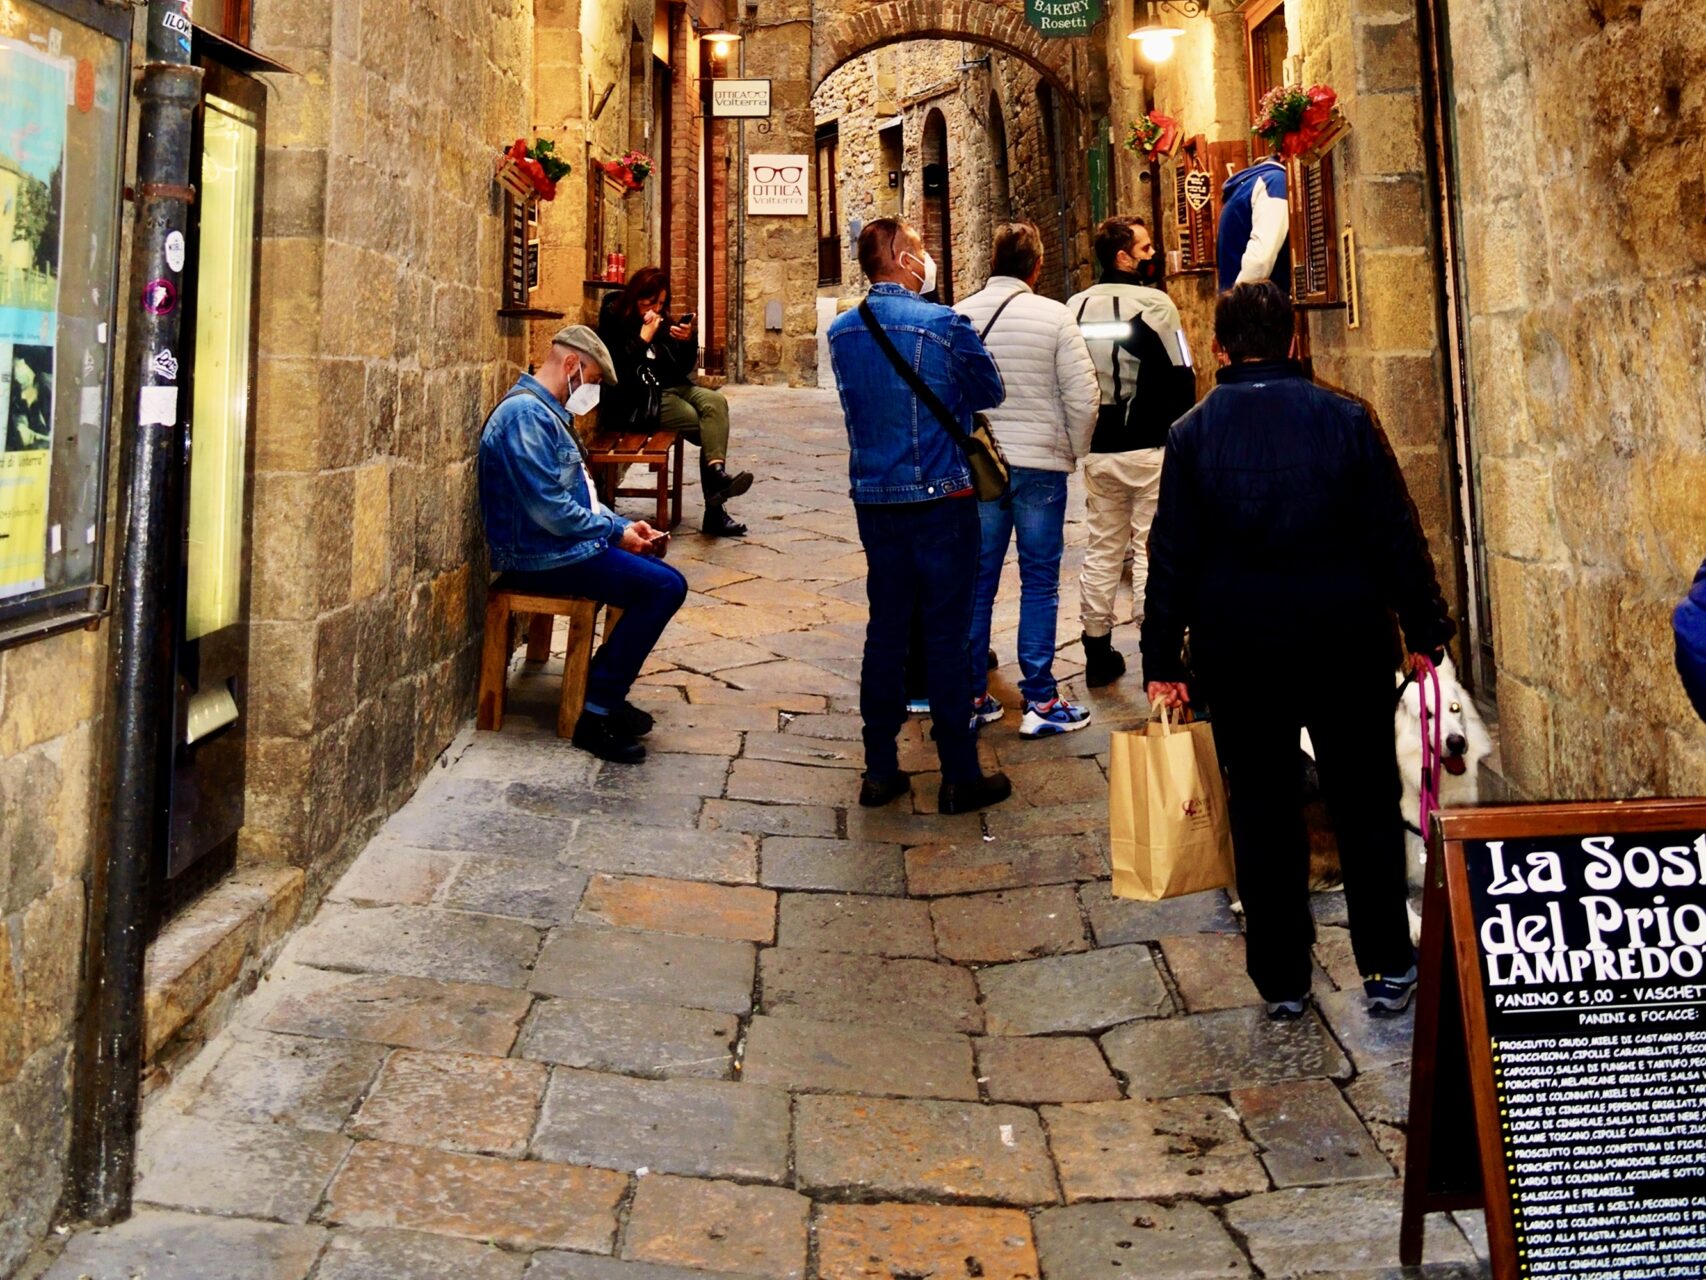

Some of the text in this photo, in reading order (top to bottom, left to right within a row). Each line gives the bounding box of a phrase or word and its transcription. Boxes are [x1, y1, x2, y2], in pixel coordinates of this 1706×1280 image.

[1033, 0, 1090, 16] BAKERY
[1040, 15, 1087, 29] Rosetti
[714, 90, 747, 99] OTTICA
[714, 99, 767, 107] Volterra
[753, 184, 802, 196] OTTICA
[753, 196, 803, 205] Volterra
[1485, 841, 1567, 895] La
[1480, 895, 1706, 955] del Prio
[1486, 943, 1706, 986] LAMPREDO
[1495, 992, 1559, 1008] PANINO
[1562, 991, 1575, 1005] €
[1579, 989, 1614, 1006] 5,00
[1579, 1012, 1626, 1025] PANINI
[1641, 1008, 1699, 1023] FOCACCE:
[1500, 1039, 1556, 1050] PROSCIUTTO
[1621, 1035, 1632, 1044] DI
[1587, 1063, 1598, 1073] DI
[1601, 1062, 1636, 1071] FUNGHI
[1638, 1061, 1644, 1070] E
[1507, 1094, 1534, 1104] LARDO
[1536, 1093, 1547, 1102] DI
[1630, 1088, 1640, 1097] DI
[1644, 1087, 1674, 1096] ACACIA
[1677, 1086, 1687, 1094] AL
[1509, 1107, 1542, 1117] SALAME
[1545, 1106, 1556, 1116] DI
[1511, 1121, 1540, 1131] LONZA
[1543, 1120, 1554, 1129] DI
[1636, 1115, 1647, 1124] DI
[1650, 1113, 1675, 1123] OLIVE
[1513, 1133, 1546, 1144] SALAME
[1515, 1147, 1570, 1158] PROSCIUTTO
[1664, 1141, 1675, 1150] DI
[1517, 1162, 1570, 1172] PORCHETTA
[1518, 1176, 1548, 1186] LARDO
[1551, 1175, 1563, 1185] DI
[1673, 1167, 1704, 1177] SOTTO
[1521, 1186, 1634, 1201] SALSICCIA E FRIARIELLI
[1523, 1205, 1562, 1216] VERDURE
[1565, 1203, 1594, 1213] MISTE
[1524, 1220, 1554, 1230] LARDO
[1557, 1219, 1568, 1228] DI
[1684, 1211, 1689, 1221] E
[1527, 1234, 1551, 1244] UOVO
[1555, 1234, 1575, 1242] ALLA
[1650, 1228, 1660, 1237] DI
[1663, 1225, 1697, 1235] FUNGHI
[1700, 1224, 1705, 1233] E
[1530, 1262, 1555, 1272] LONZA
[1558, 1261, 1567, 1270] DI
[1663, 1254, 1672, 1263] DI
